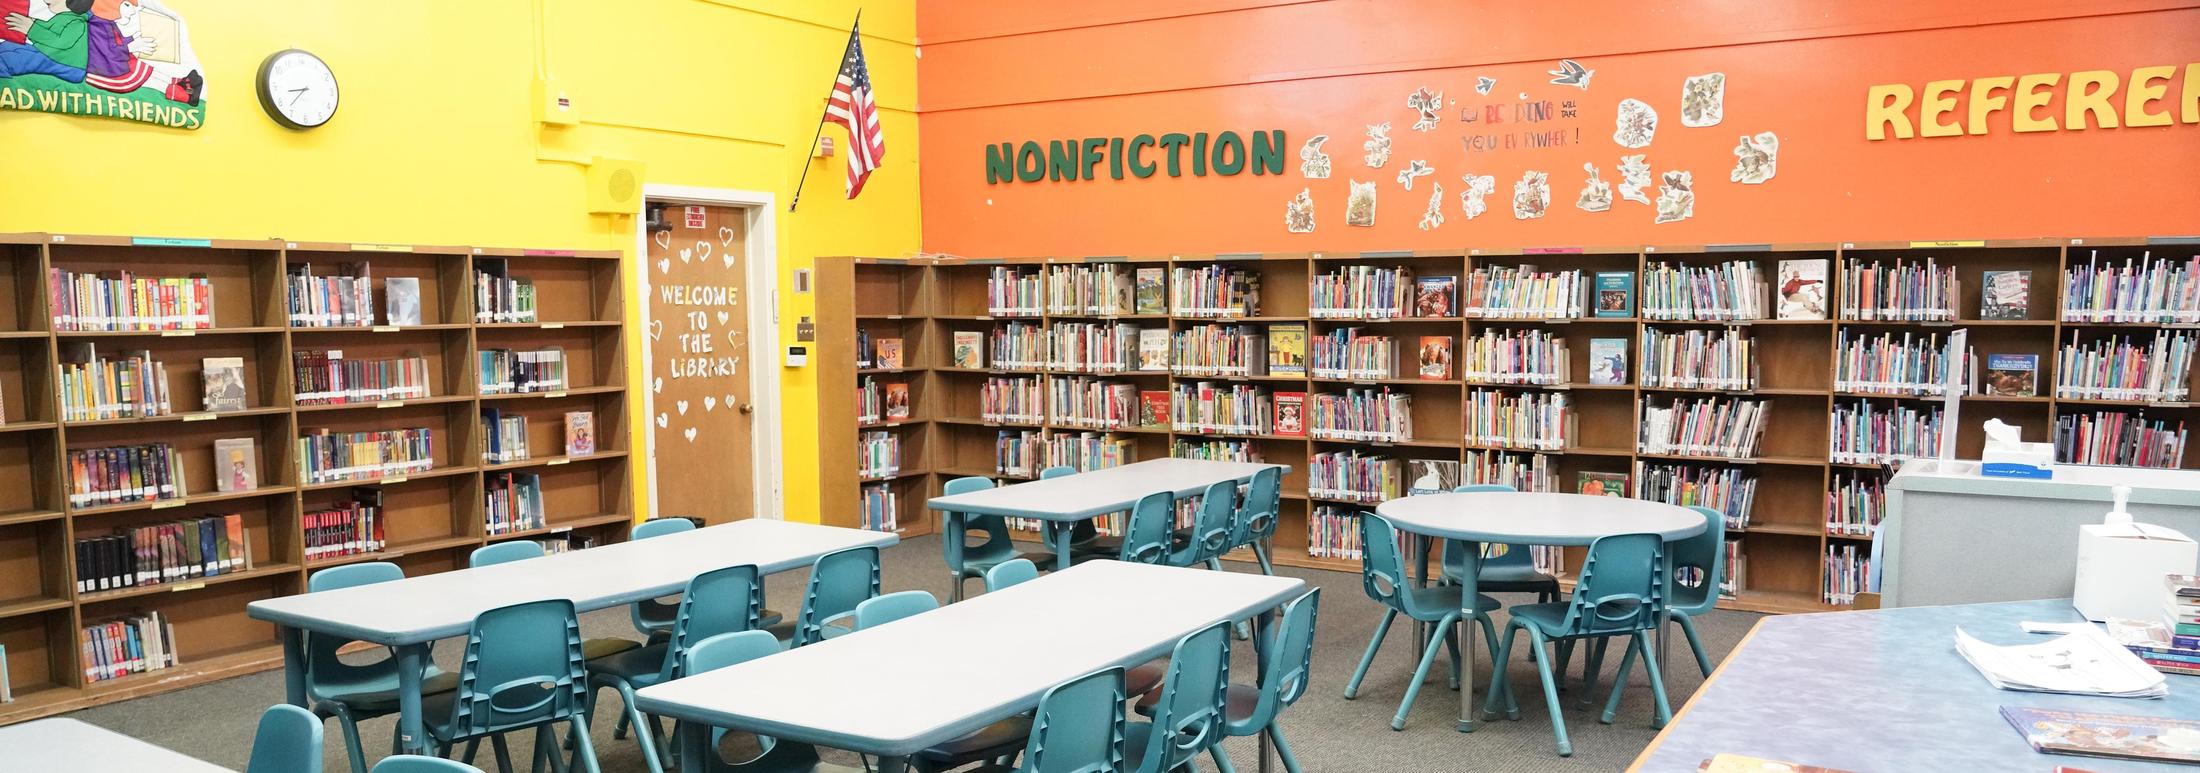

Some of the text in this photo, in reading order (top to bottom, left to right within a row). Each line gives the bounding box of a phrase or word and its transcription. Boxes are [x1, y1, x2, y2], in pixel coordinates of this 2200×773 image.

[37, 88, 103, 117] WITH
[107, 96, 201, 131] FRIENDS
[1485, 101, 1554, 125] REDING
[985, 129, 1286, 185] NONFICTION
[660, 285, 738, 306] WELCOME
[688, 311, 708, 331] TO
[679, 333, 713, 354] THE
